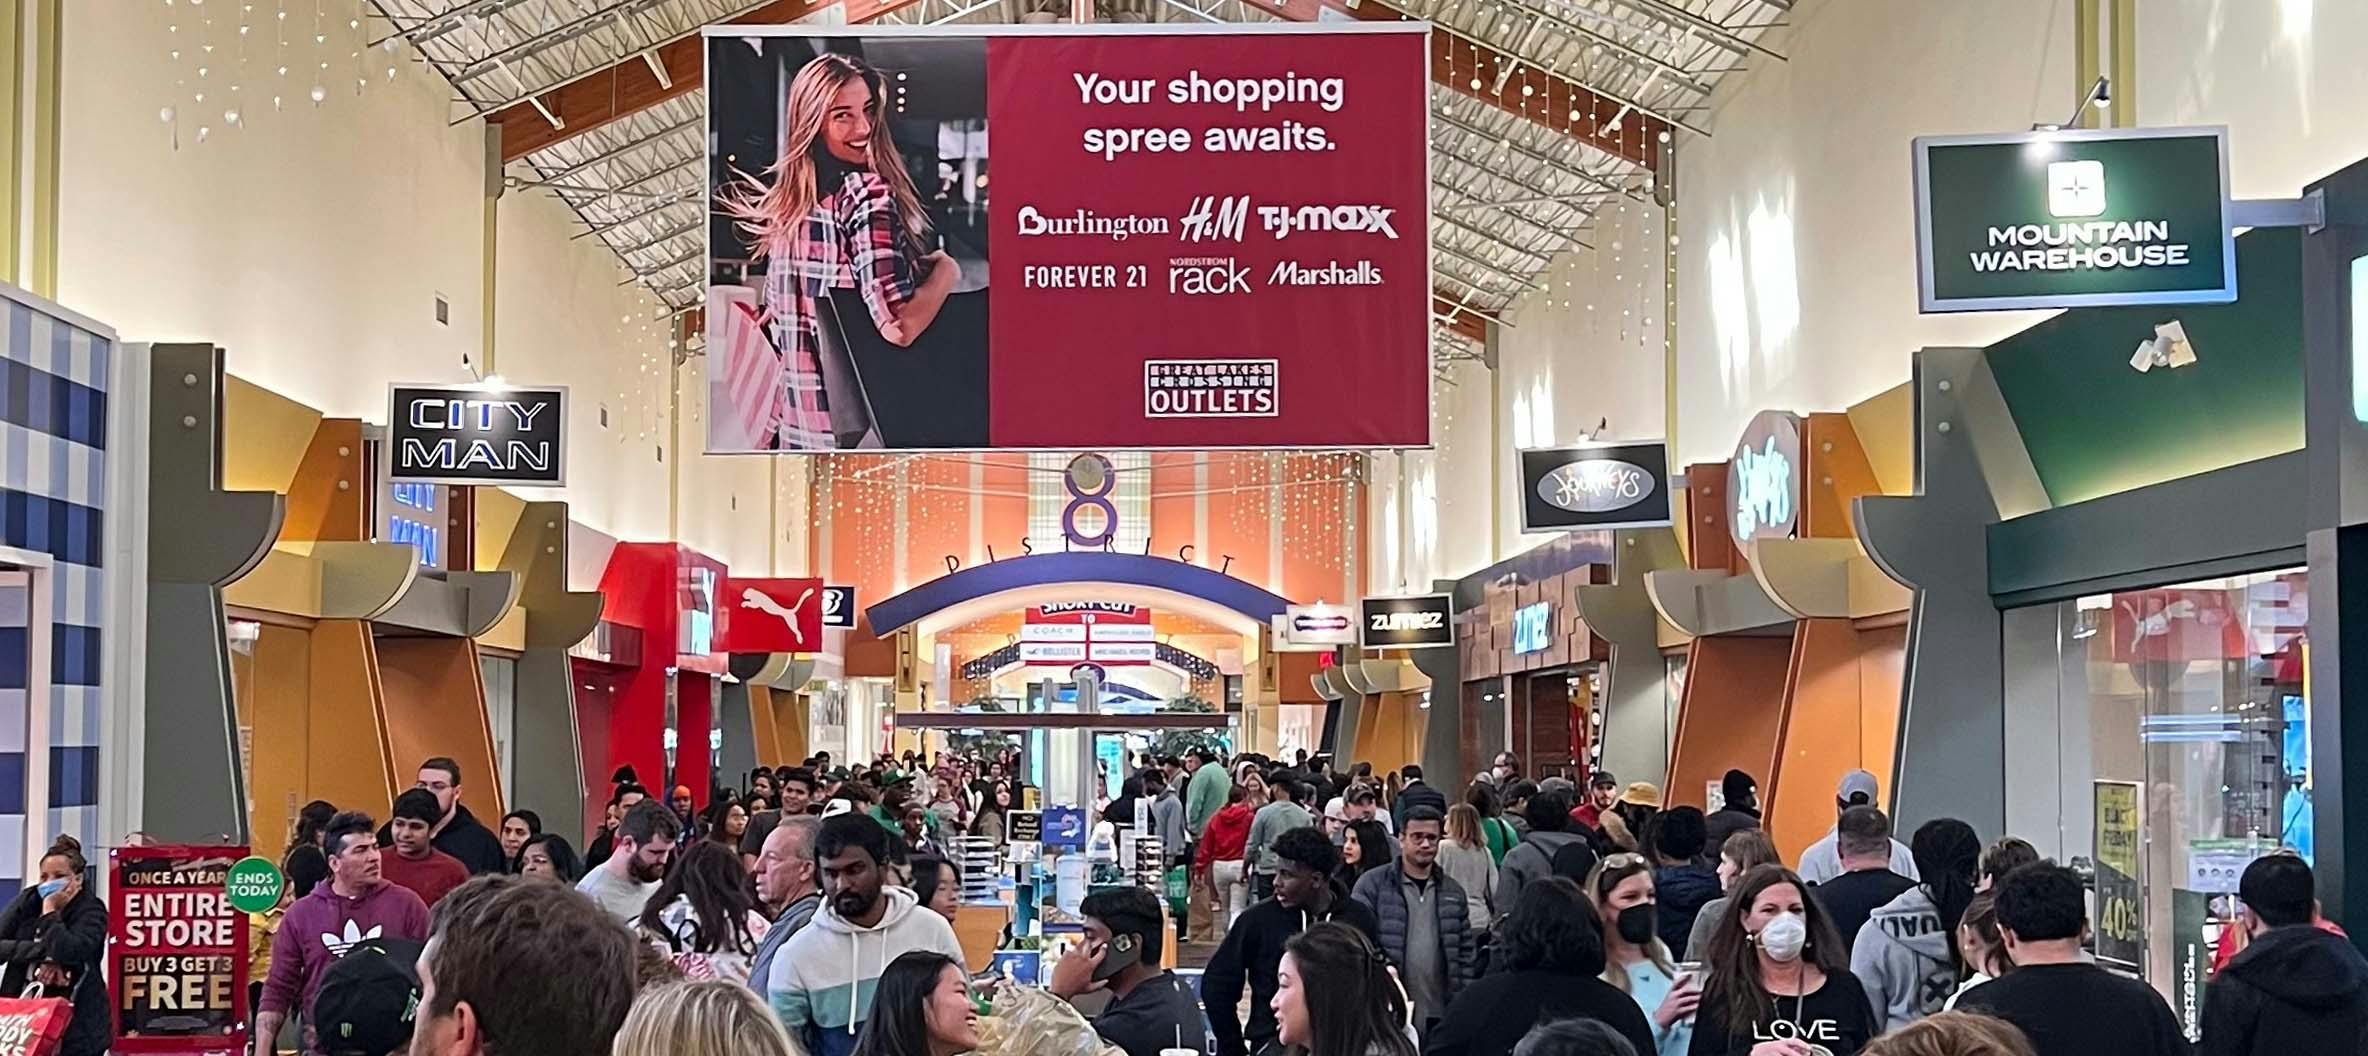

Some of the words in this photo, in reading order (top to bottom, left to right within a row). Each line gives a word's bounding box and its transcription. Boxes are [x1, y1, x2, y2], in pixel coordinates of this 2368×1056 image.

[1073, 72, 1156, 104] Your
[1168, 70, 1344, 112] shopping
[1083, 126, 1192, 161] spree
[1204, 120, 1336, 152] awaits.
[1018, 206, 1169, 241] Burlington
[1180, 195, 1250, 243] H&M
[1988, 220, 2169, 247] MOUNTAIN
[1169, 257, 1228, 266] NORDSTROM
[1969, 244, 2190, 272] WAREHOUSE
[1024, 265, 1117, 288] FOREVER
[1126, 265, 1147, 288] 21
[1169, 257, 1252, 294] rack
[1157, 365, 1206, 376] GREAT
[1213, 364, 1266, 375] LAKES
[1157, 376, 1266, 387] CROSSING
[1150, 389, 1273, 413] OUTLETS
[410, 399, 548, 431] CITY
[402, 438, 549, 470] MAN
[1063, 453, 1118, 547] 8
[944, 533, 1234, 575] DISTRICT
[1033, 627, 1074, 635] COACH
[128, 871, 171, 885] ONCE
[173, 872, 185, 884] A
[187, 871, 226, 885] YEAR
[230, 884, 279, 897] TODAY
[235, 873, 274, 885] ENDS
[125, 893, 234, 918] ENTIRE
[125, 919, 234, 946] STORE
[124, 956, 165, 972] BUY
[166, 957, 178, 972] 3
[181, 956, 216, 972] GET
[221, 956, 233, 972] 3
[123, 974, 233, 1010] FREE
[1752, 1019, 1840, 1040] LOVE
